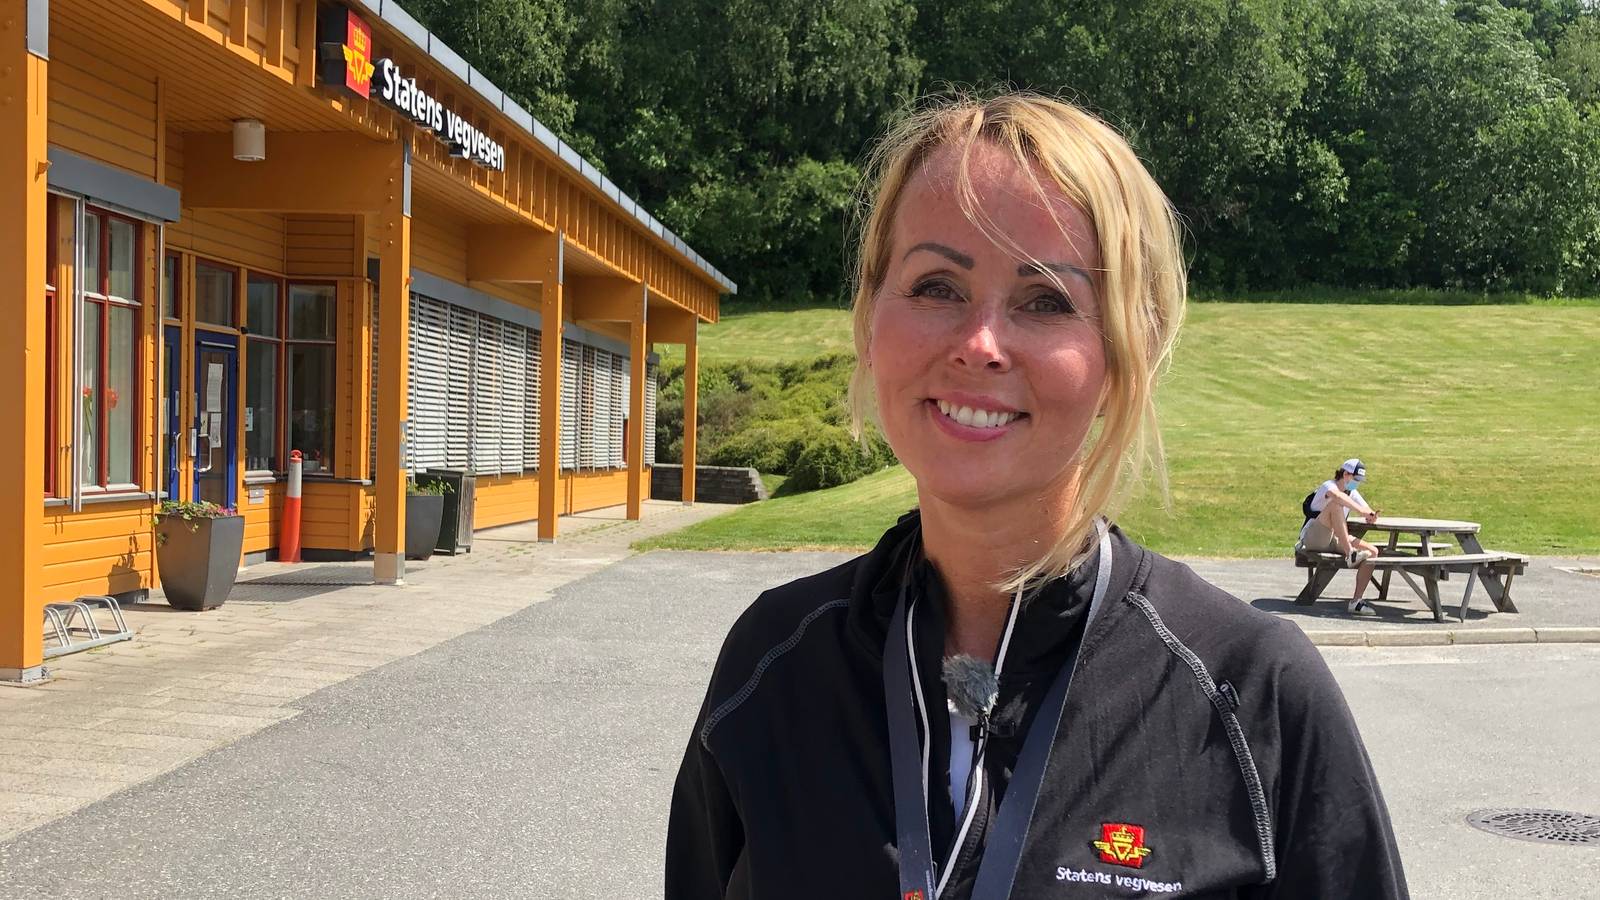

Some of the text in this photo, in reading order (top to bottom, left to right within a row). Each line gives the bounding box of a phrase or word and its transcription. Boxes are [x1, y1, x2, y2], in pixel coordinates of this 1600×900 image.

[383, 58, 504, 172] Statens vegvesen
[1056, 866, 1182, 892] Statens vegvesen
